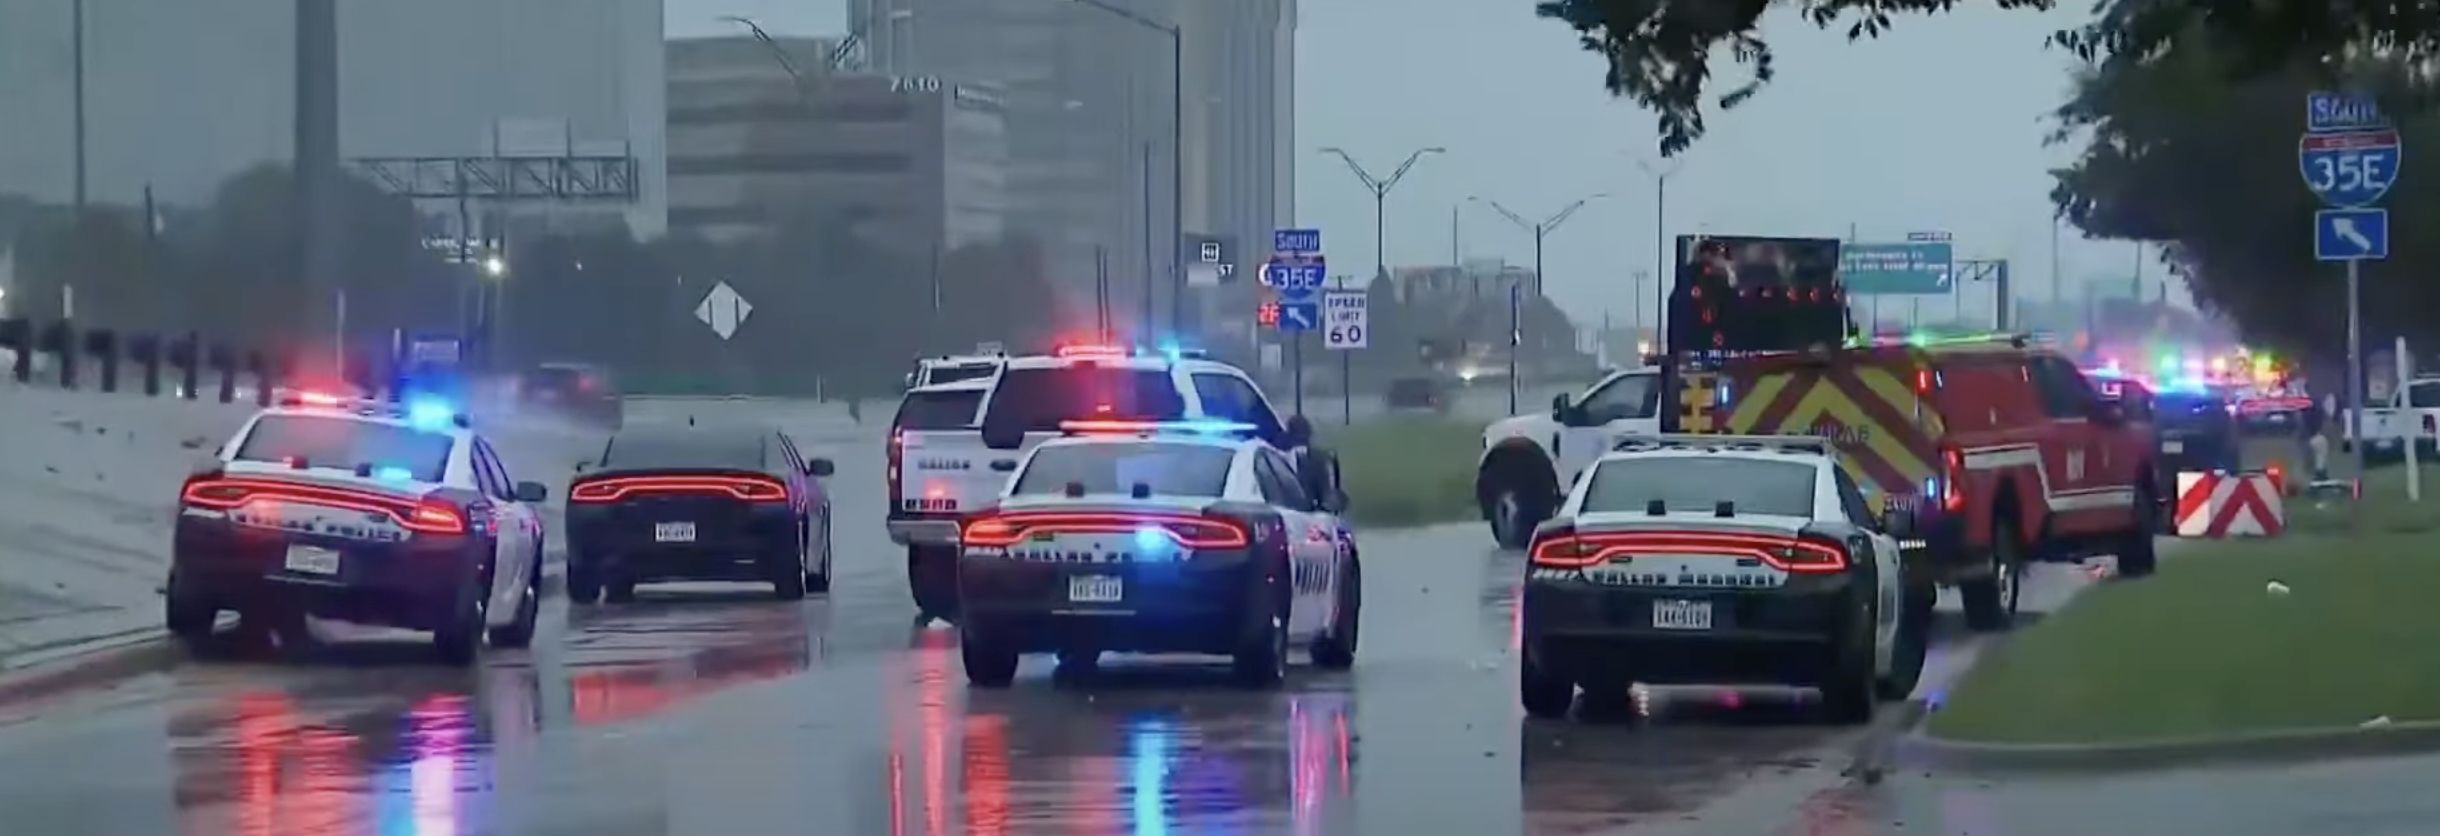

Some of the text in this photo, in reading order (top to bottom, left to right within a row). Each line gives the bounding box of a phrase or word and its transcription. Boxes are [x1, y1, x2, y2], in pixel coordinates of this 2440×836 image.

[2314, 155, 2386, 190] 35E
[1276, 268, 1317, 289] 35E
[1330, 325, 1361, 343] 60
